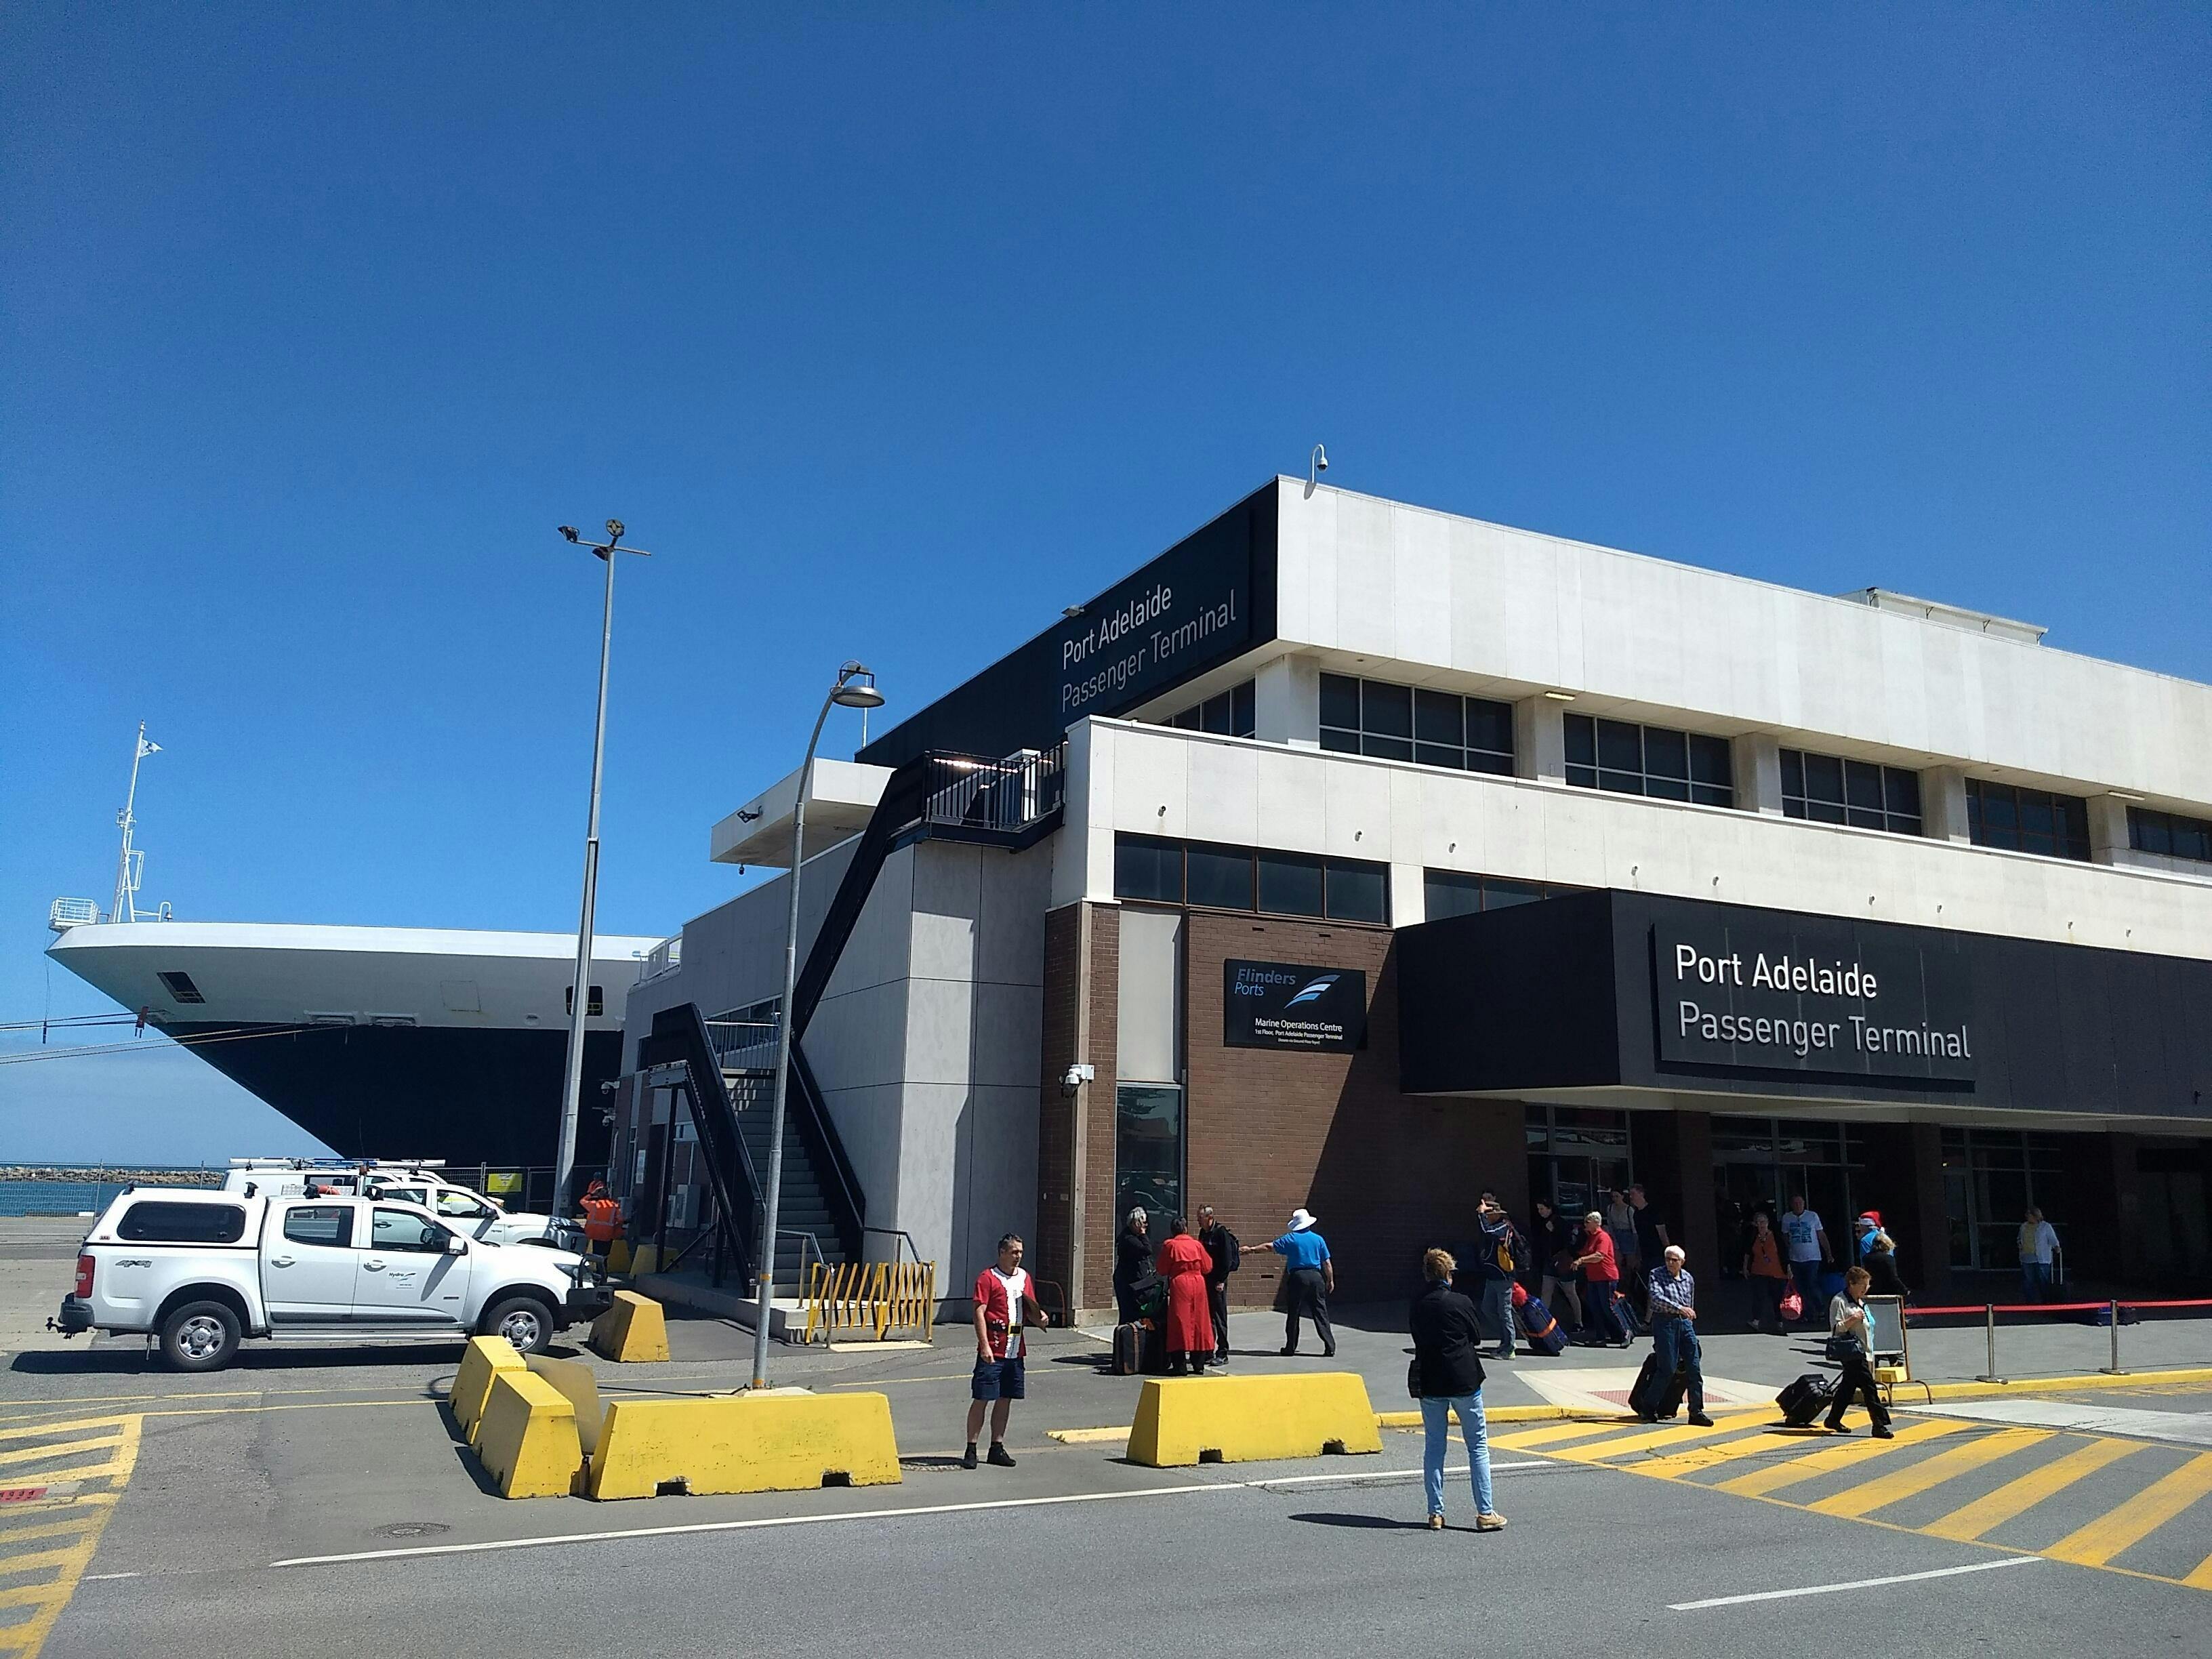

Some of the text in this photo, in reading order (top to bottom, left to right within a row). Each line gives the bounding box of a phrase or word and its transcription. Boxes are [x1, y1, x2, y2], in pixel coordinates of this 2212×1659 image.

[1062, 588, 1237, 713] Passenger Terminal
[1063, 583, 1172, 670] Port Adelaide
[1234, 981, 1265, 996] Ports
[1237, 968, 1296, 985] Flinders
[1676, 944, 1877, 998] Port Adelaide
[1255, 1018, 1343, 1032] Marine Operations Centre
[1679, 1001, 1971, 1058] Passenger Terminal
